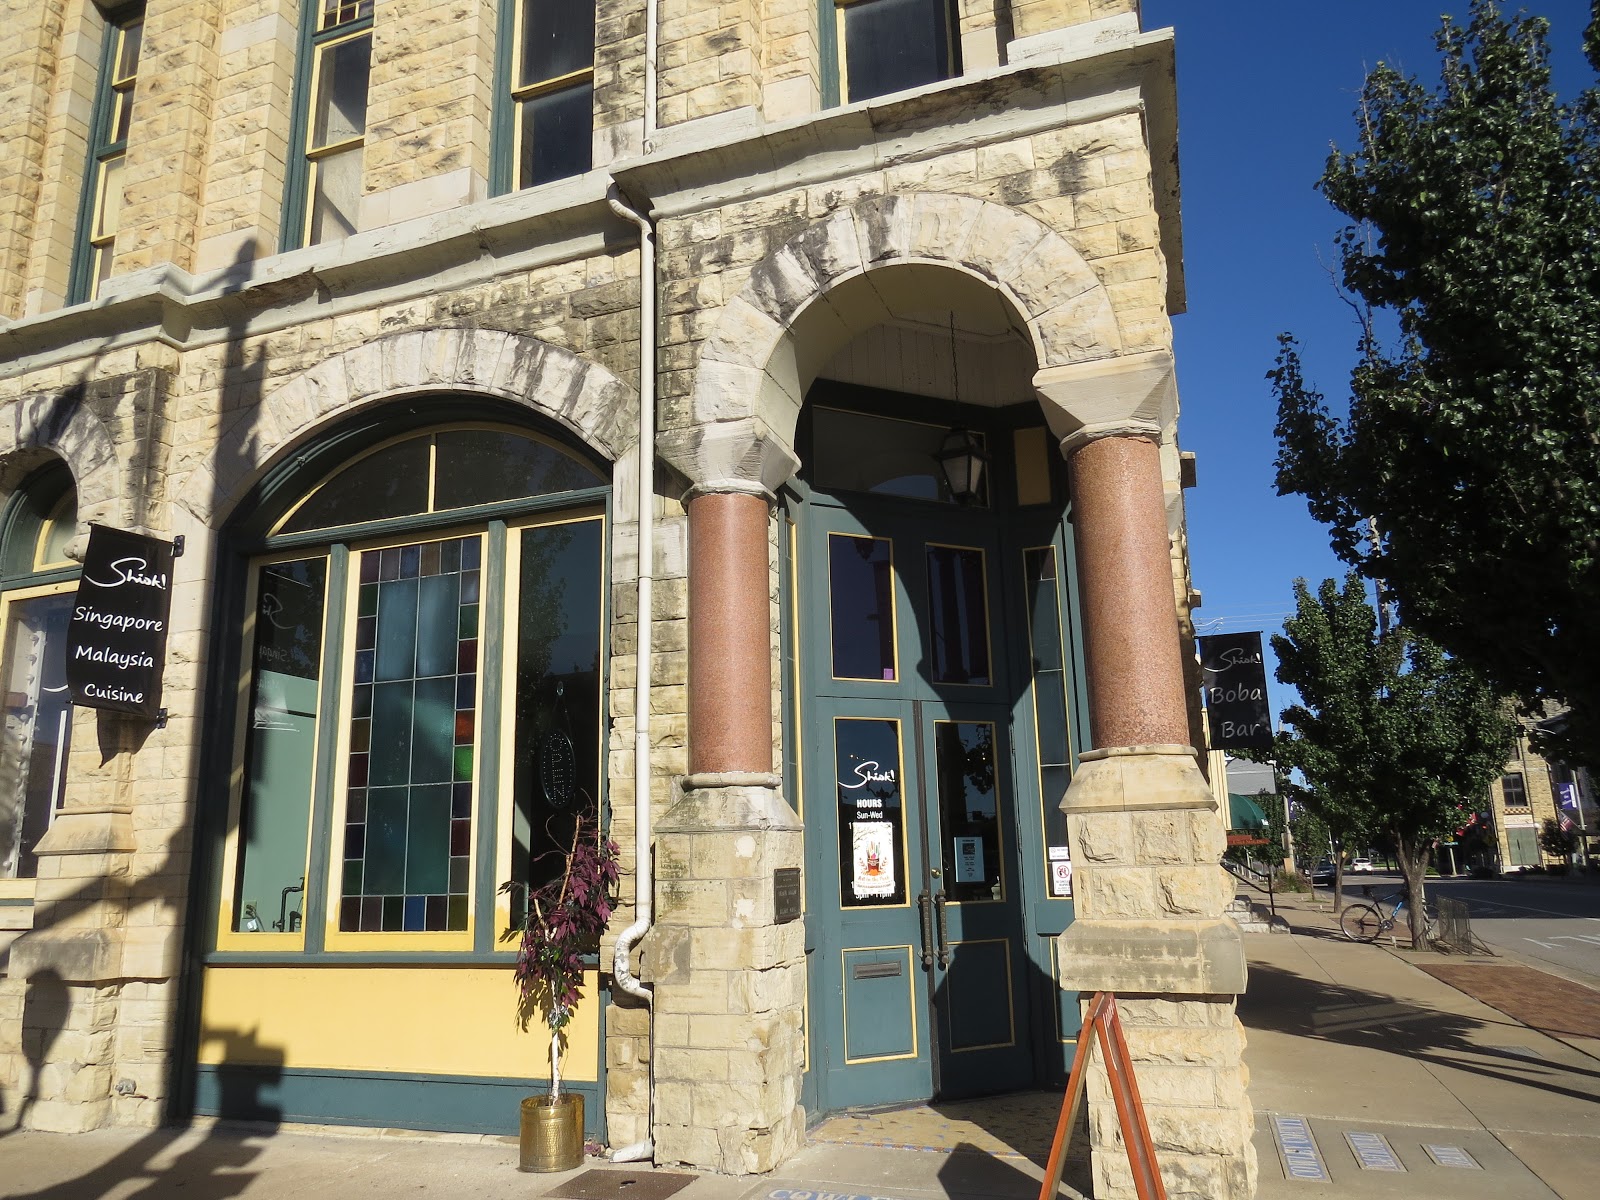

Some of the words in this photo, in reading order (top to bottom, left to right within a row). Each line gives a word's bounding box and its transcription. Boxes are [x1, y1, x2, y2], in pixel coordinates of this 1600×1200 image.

[84, 557, 167, 590] Shiok!
[73, 606, 163, 632] Singapore
[75, 645, 154, 670] Malaysia
[84, 683, 144, 704] Cuisine
[1210, 683, 1262, 704] Boba
[1221, 721, 1260, 738] Bar
[549, 737, 565, 800] OPEN
[837, 760, 896, 789] Shiok!
[856, 799, 882, 808] HOURS
[856, 811, 883, 819] Sun-Wed
